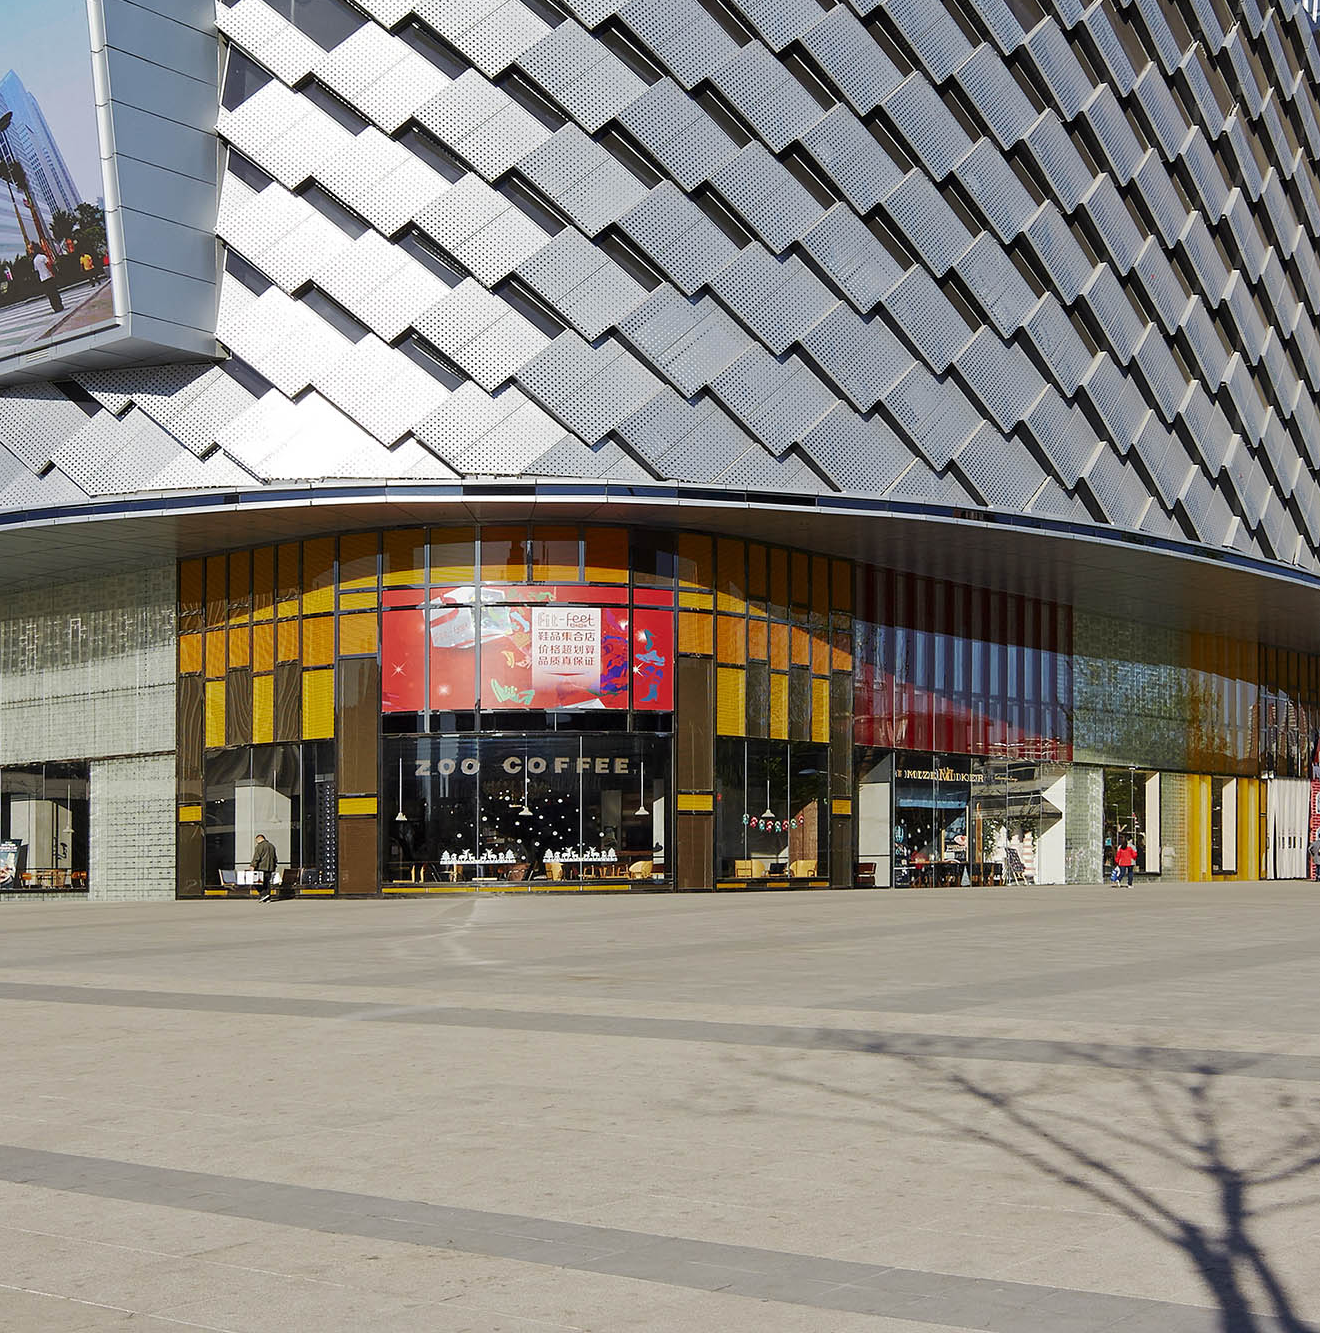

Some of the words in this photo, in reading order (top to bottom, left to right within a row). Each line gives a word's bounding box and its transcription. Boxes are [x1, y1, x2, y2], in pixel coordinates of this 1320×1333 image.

[537, 631, 596, 642] 鞋品集合店
[538, 644, 596, 655] 价格超划算
[538, 656, 595, 666] 品质真保证
[415, 757, 480, 777] ZOO
[502, 756, 630, 775] COFFEE
